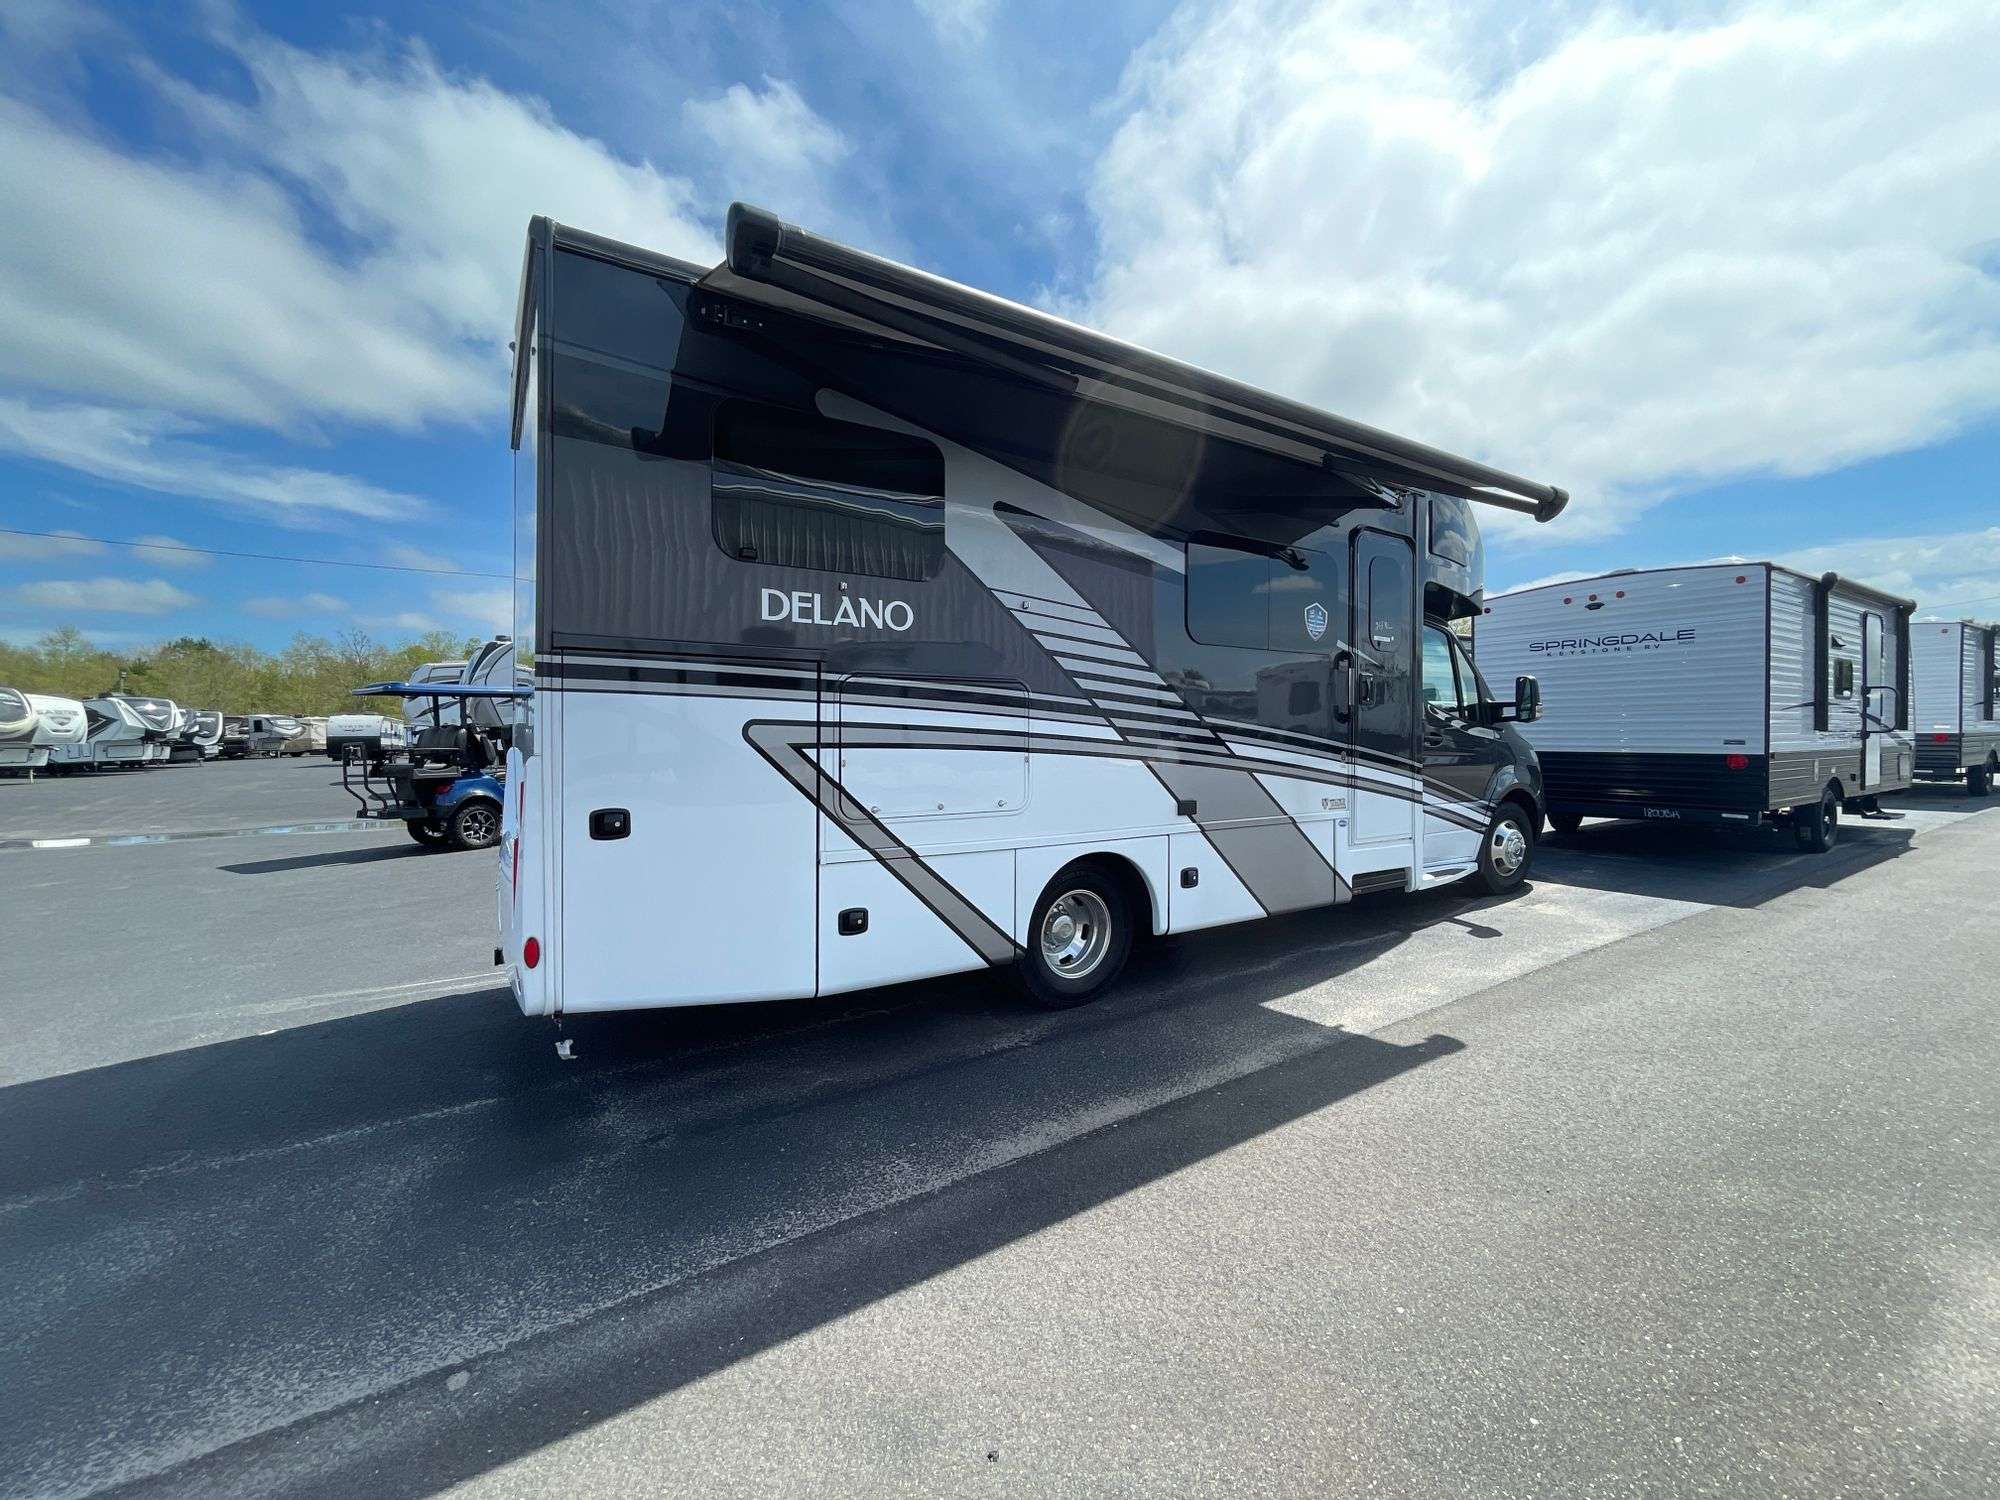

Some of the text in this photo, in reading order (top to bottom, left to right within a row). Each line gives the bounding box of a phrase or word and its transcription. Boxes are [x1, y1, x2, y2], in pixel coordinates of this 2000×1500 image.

[761, 588, 914, 631] DELANO
[1529, 628, 1696, 652] SPRINGDALE
[1546, 646, 1632, 657] KEYSTONE
